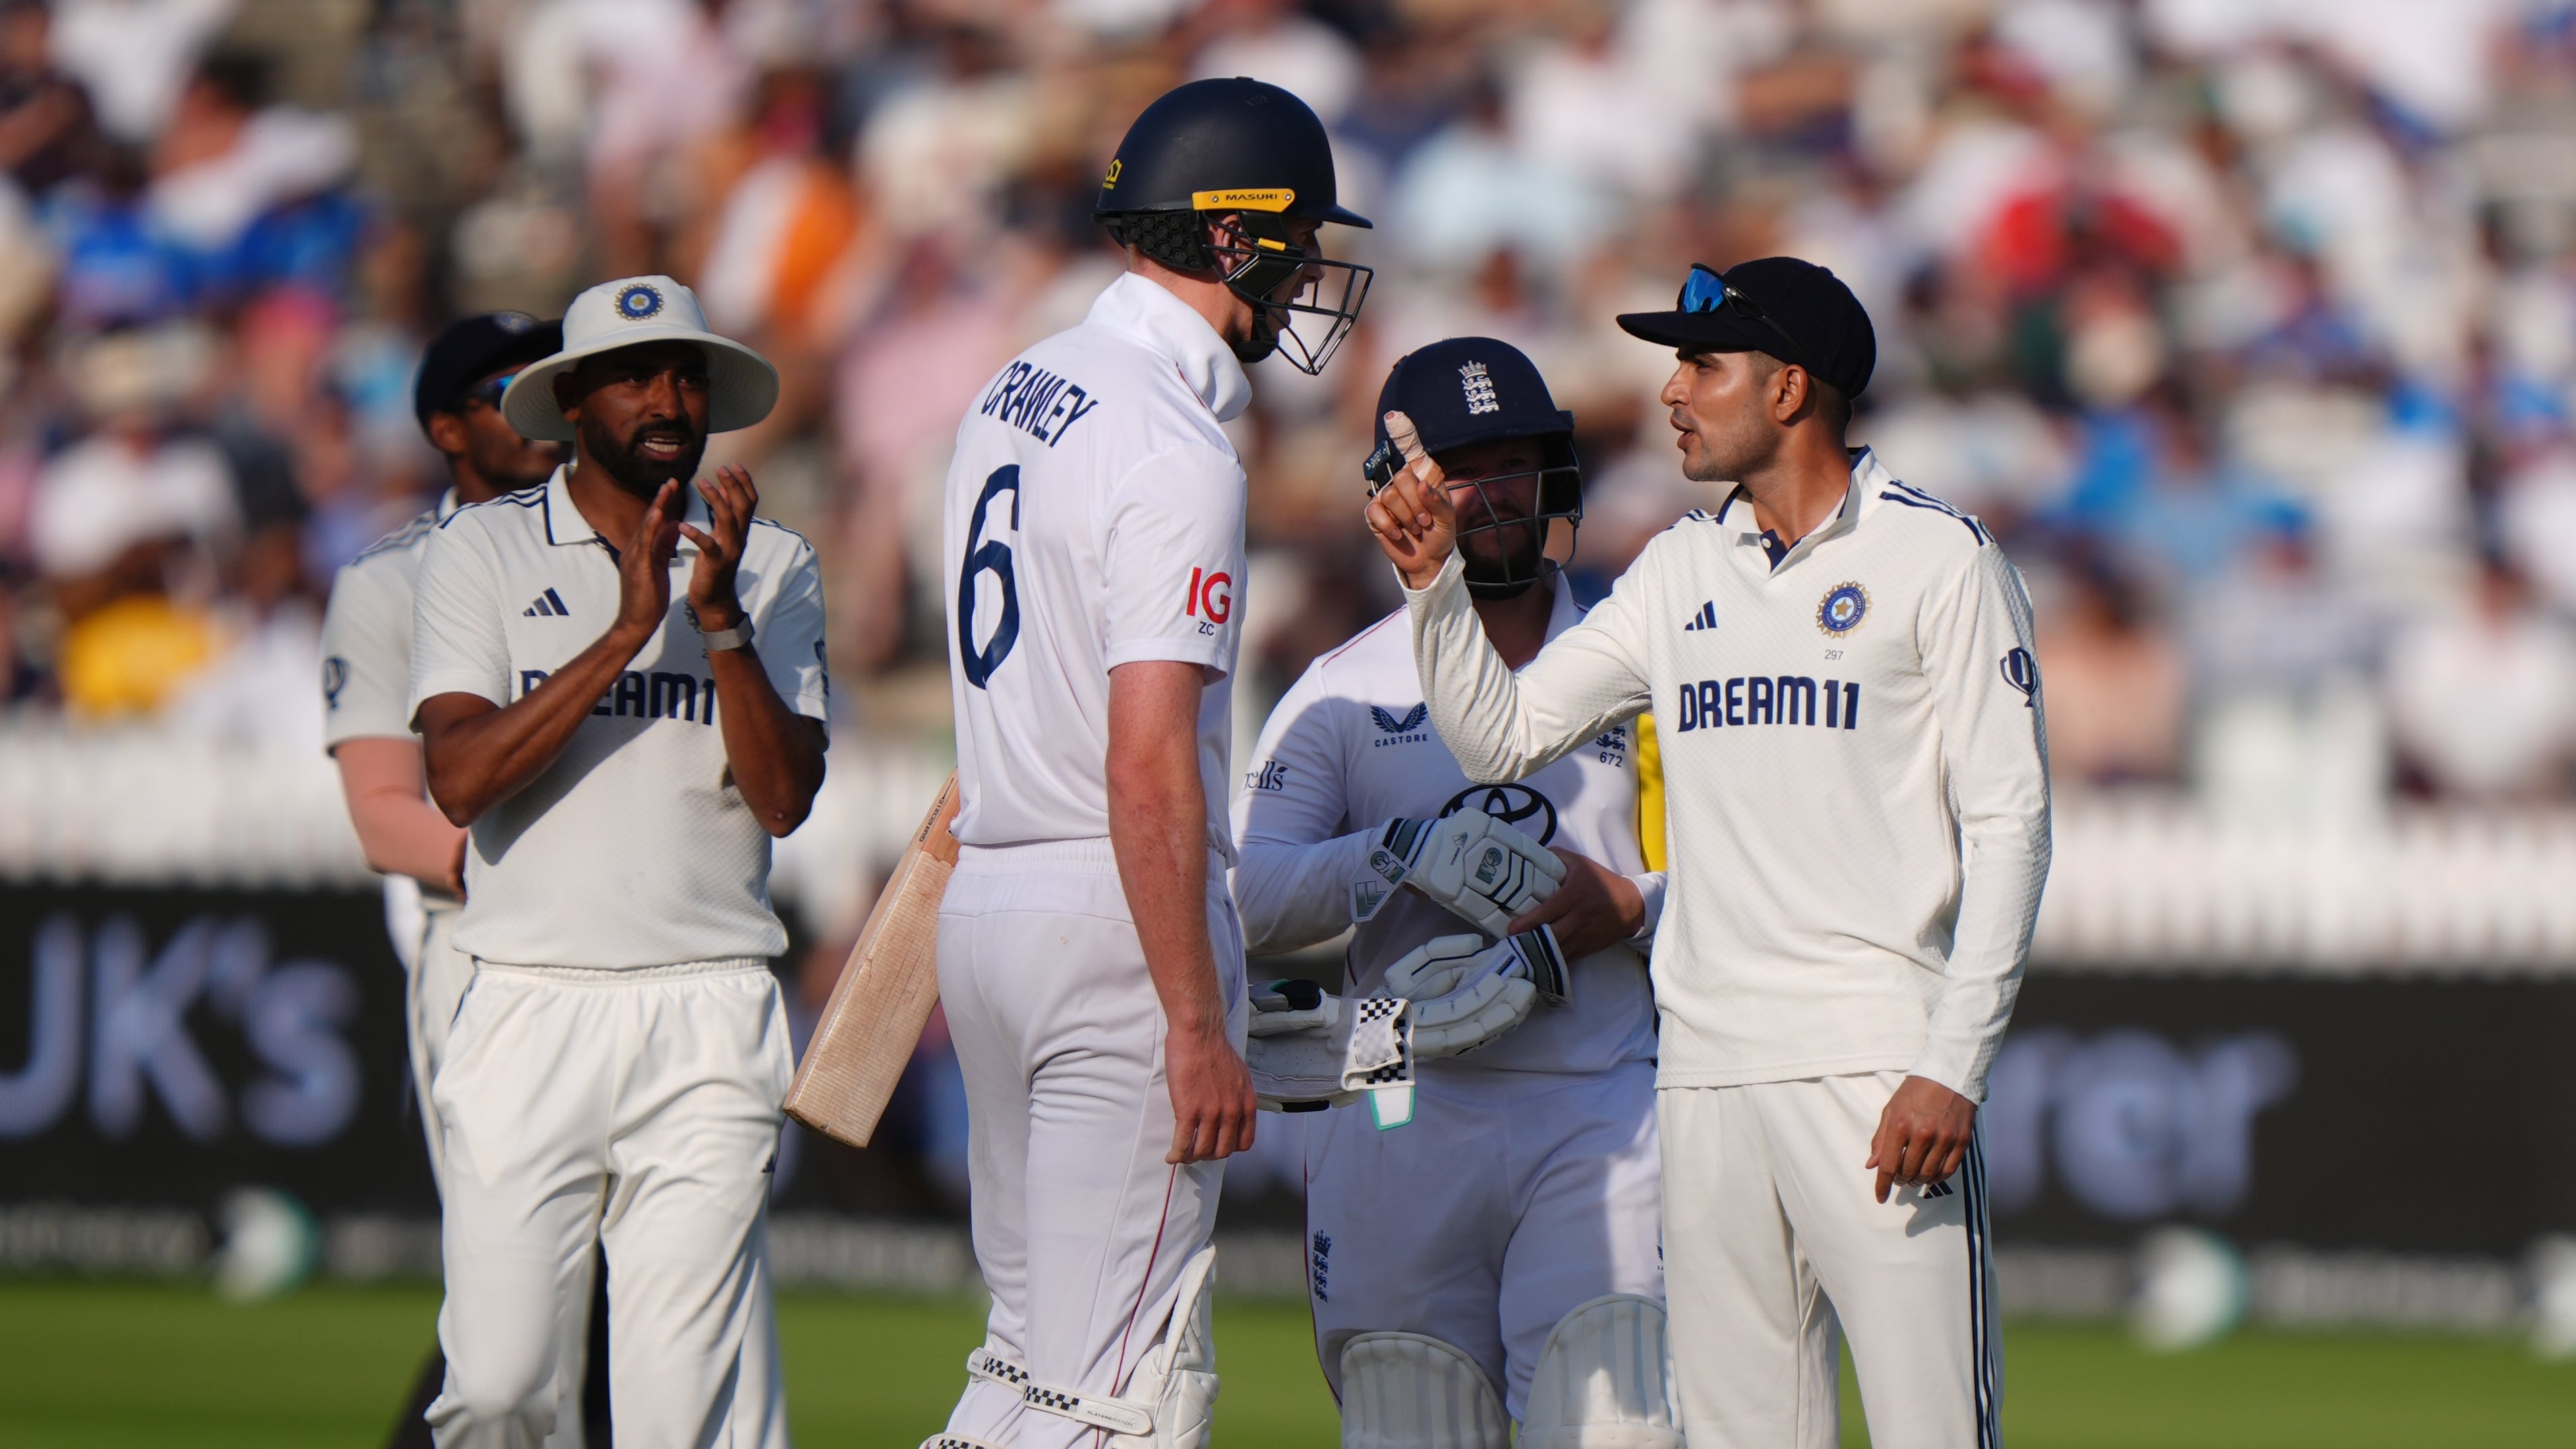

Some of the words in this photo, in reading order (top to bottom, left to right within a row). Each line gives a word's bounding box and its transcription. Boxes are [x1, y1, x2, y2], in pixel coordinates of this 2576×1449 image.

[981, 360, 1099, 448] CRAWLEY
[958, 464, 1020, 690] 6
[1186, 566, 1232, 624] IG
[1198, 621, 1214, 636] ZC
[1824, 649, 1844, 661] 297
[520, 670, 715, 726] DAM1
[1678, 676, 1860, 732] DREAM11
[1374, 734, 1428, 748] CASTORE
[1600, 752, 1623, 768] 672
[1370, 850, 1405, 885] GM
